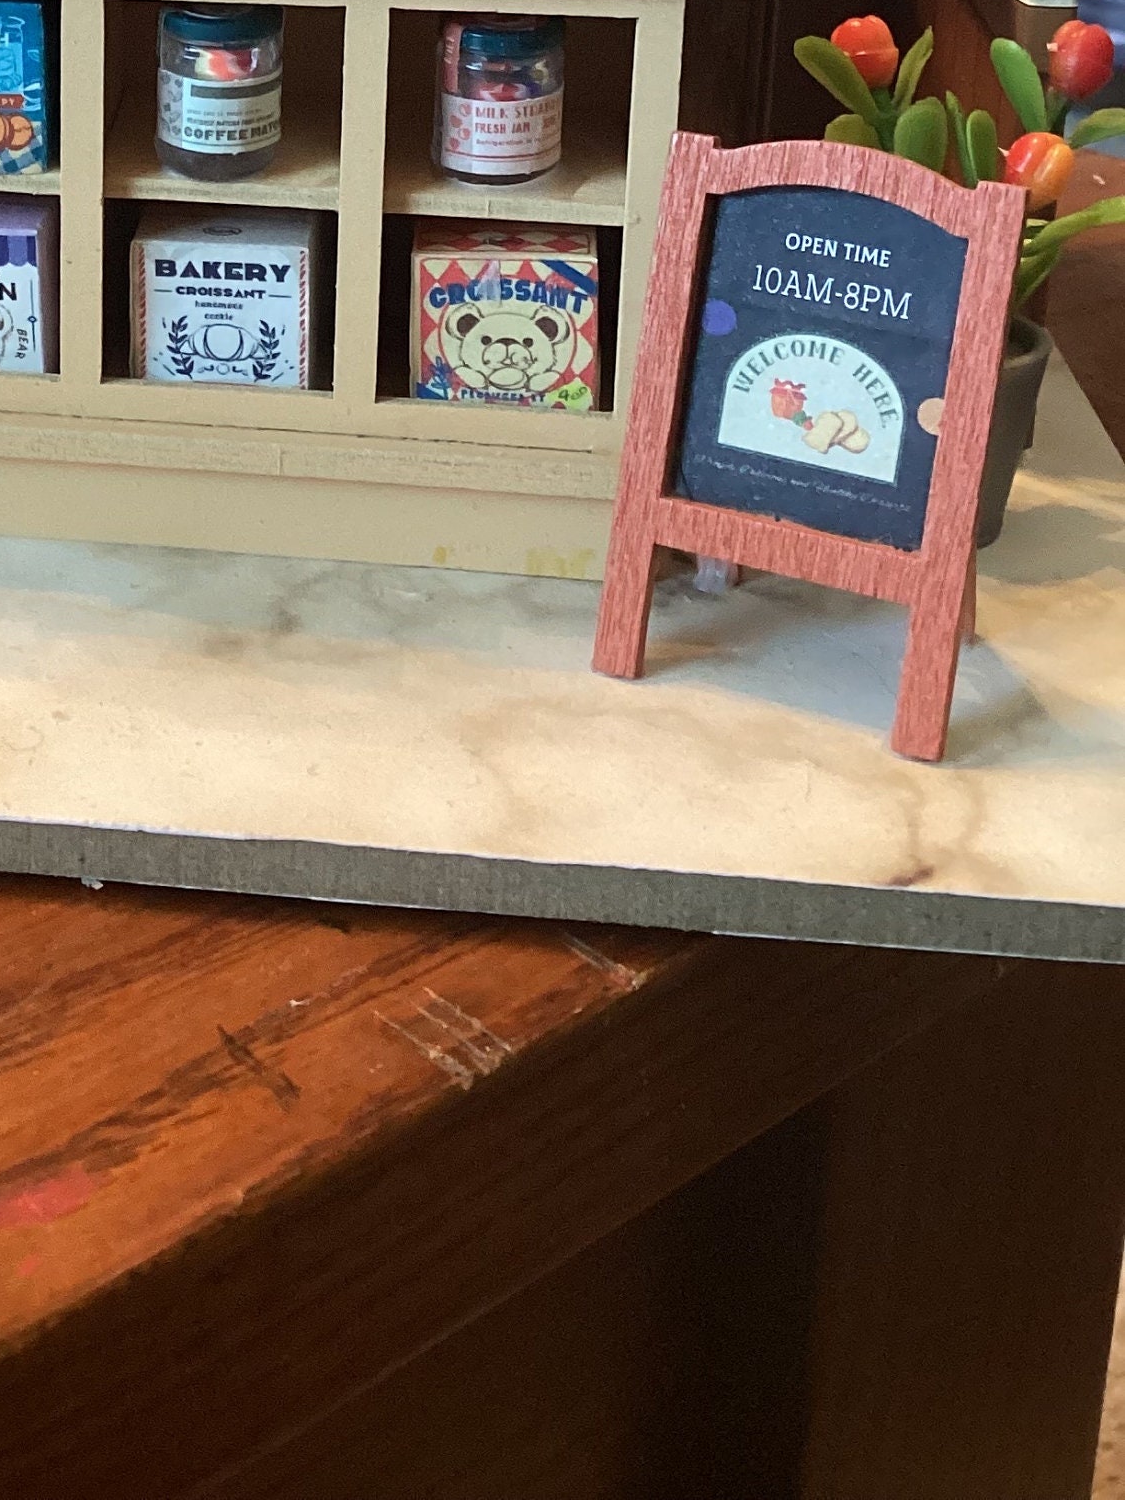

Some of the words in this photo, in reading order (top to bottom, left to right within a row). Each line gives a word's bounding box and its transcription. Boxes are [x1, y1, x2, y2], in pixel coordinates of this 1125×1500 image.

[184, 126, 249, 141] COFFEE
[785, 233, 838, 258] OPEN
[843, 243, 892, 268] TIME
[155, 259, 291, 283] BAKERY
[176, 286, 267, 300] CROISSANT
[429, 278, 589, 315] CROISSANT
[752, 264, 913, 320] 10AM-8PM
[17, 328, 28, 359] BEAR
[733, 339, 845, 394] WELCOME
[852, 363, 900, 429] HERE
